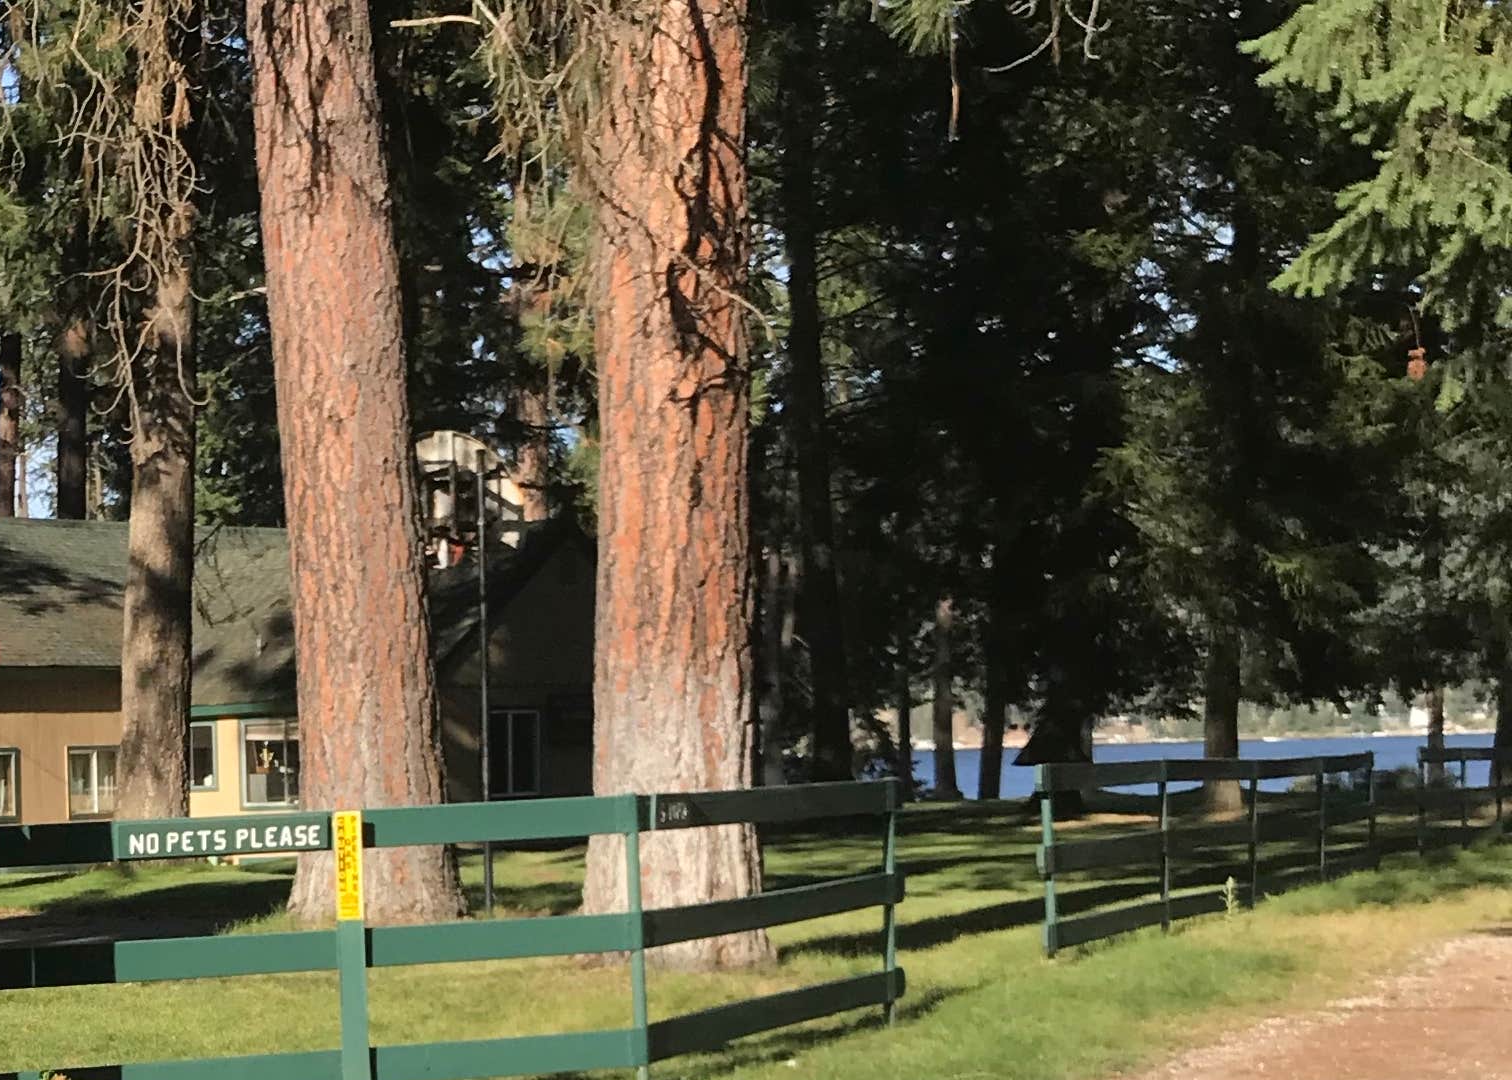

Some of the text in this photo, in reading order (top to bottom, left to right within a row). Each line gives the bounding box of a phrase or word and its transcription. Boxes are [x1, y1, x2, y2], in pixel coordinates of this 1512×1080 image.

[128, 825, 321, 855] NO PETS PLEASE
